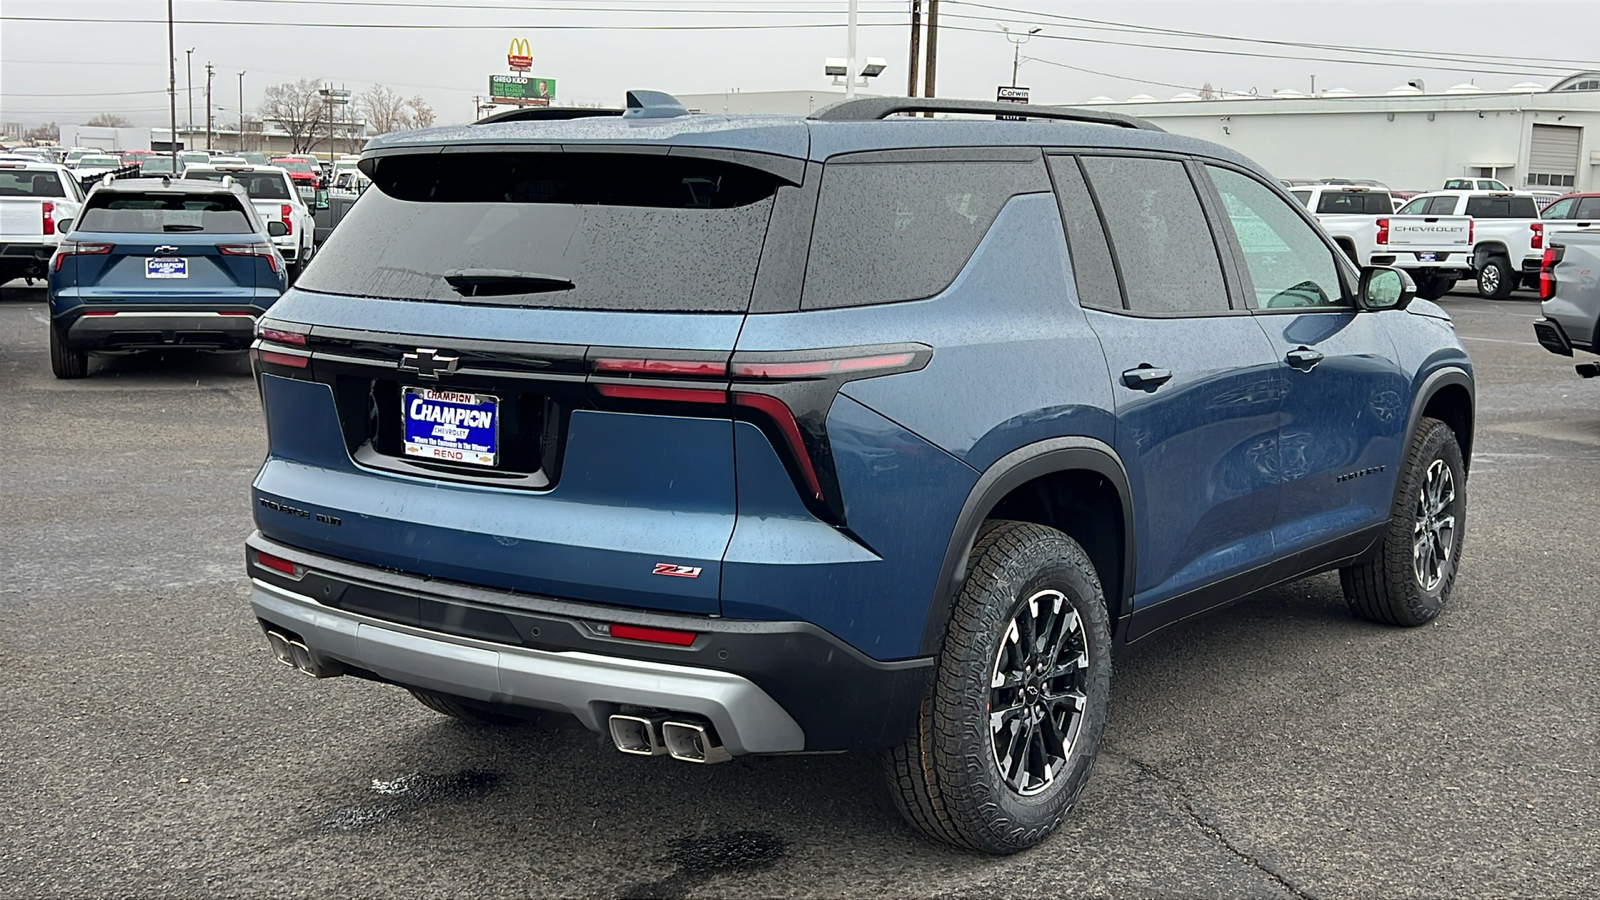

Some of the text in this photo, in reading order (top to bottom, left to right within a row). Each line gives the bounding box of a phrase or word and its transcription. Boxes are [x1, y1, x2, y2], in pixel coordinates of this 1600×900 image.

[1001, 89, 1029, 97] Corwin
[149, 261, 184, 269] CHAMPION
[426, 390, 472, 404] CHAMPION
[410, 398, 493, 429] CHAMPION
[434, 426, 466, 437] CHEVROLET
[434, 449, 463, 460] RENO
[652, 562, 703, 578] Z71
